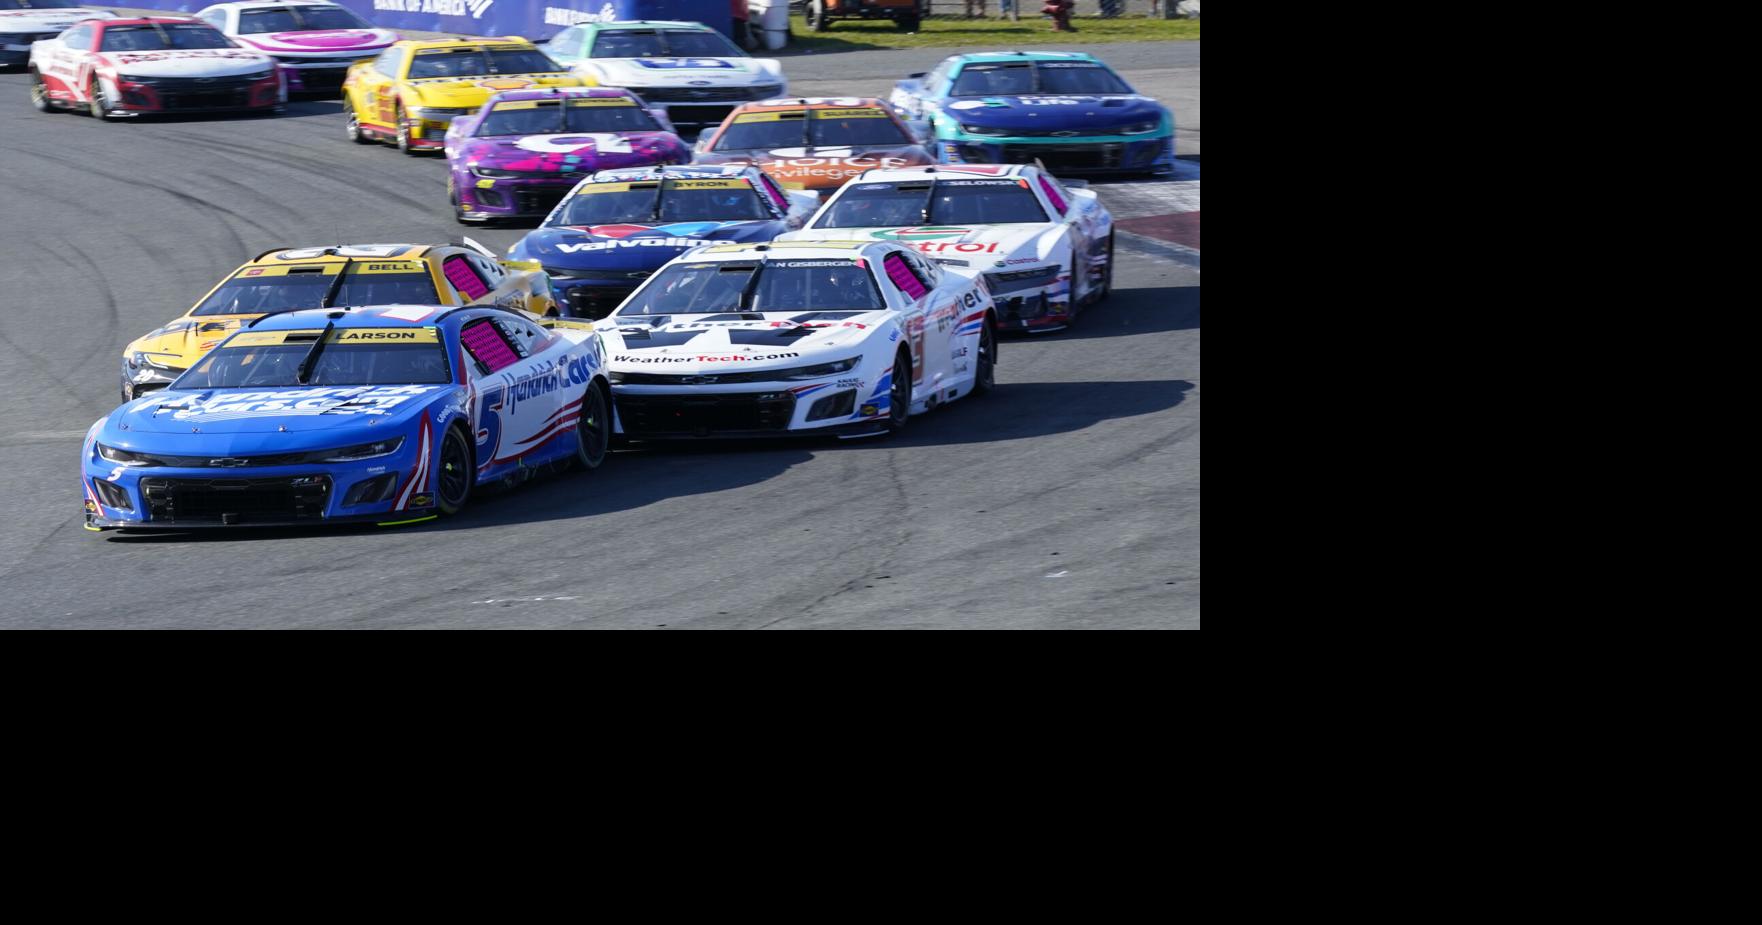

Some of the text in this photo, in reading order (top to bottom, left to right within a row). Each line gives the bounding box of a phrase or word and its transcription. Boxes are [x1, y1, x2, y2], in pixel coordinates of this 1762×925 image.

[368, 263, 414, 272] BELL
[335, 331, 416, 340] LARSON
[613, 351, 800, 364] WeatherTech.com
